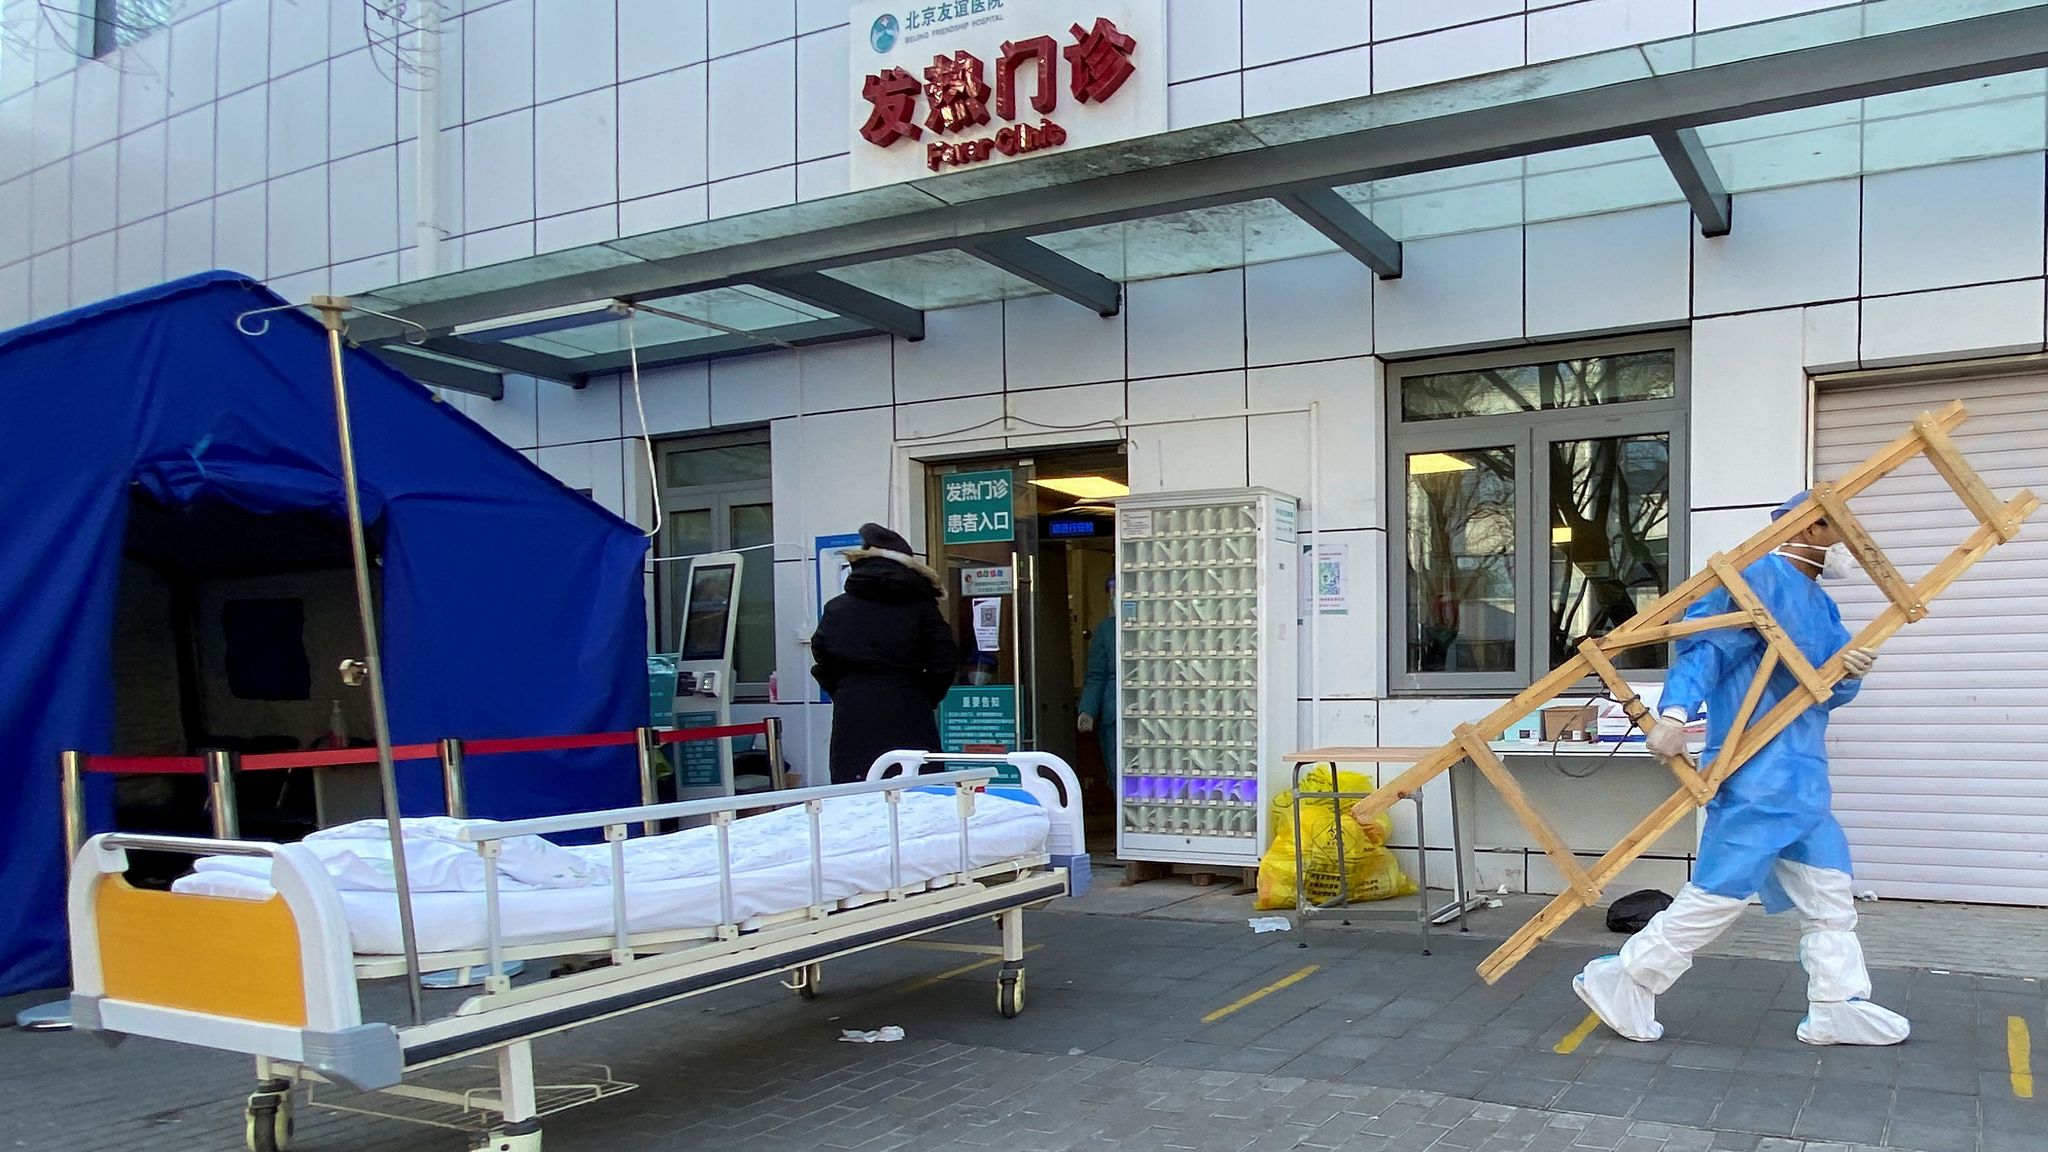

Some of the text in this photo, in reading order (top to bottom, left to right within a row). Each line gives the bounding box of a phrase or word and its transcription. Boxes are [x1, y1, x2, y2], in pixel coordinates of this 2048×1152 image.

[905, 0, 1004, 31] 北京友谊医院
[932, 22, 969, 36] FRIENDSHIP
[972, 14, 1004, 27] HOSPITAL
[859, 17, 1136, 148] 发热门诊
[927, 118, 1066, 172] Fever Clinic
[946, 479, 1009, 502] 发热门诊
[947, 511, 1009, 533] 患者入口
[962, 696, 1000, 708] 重要告知
